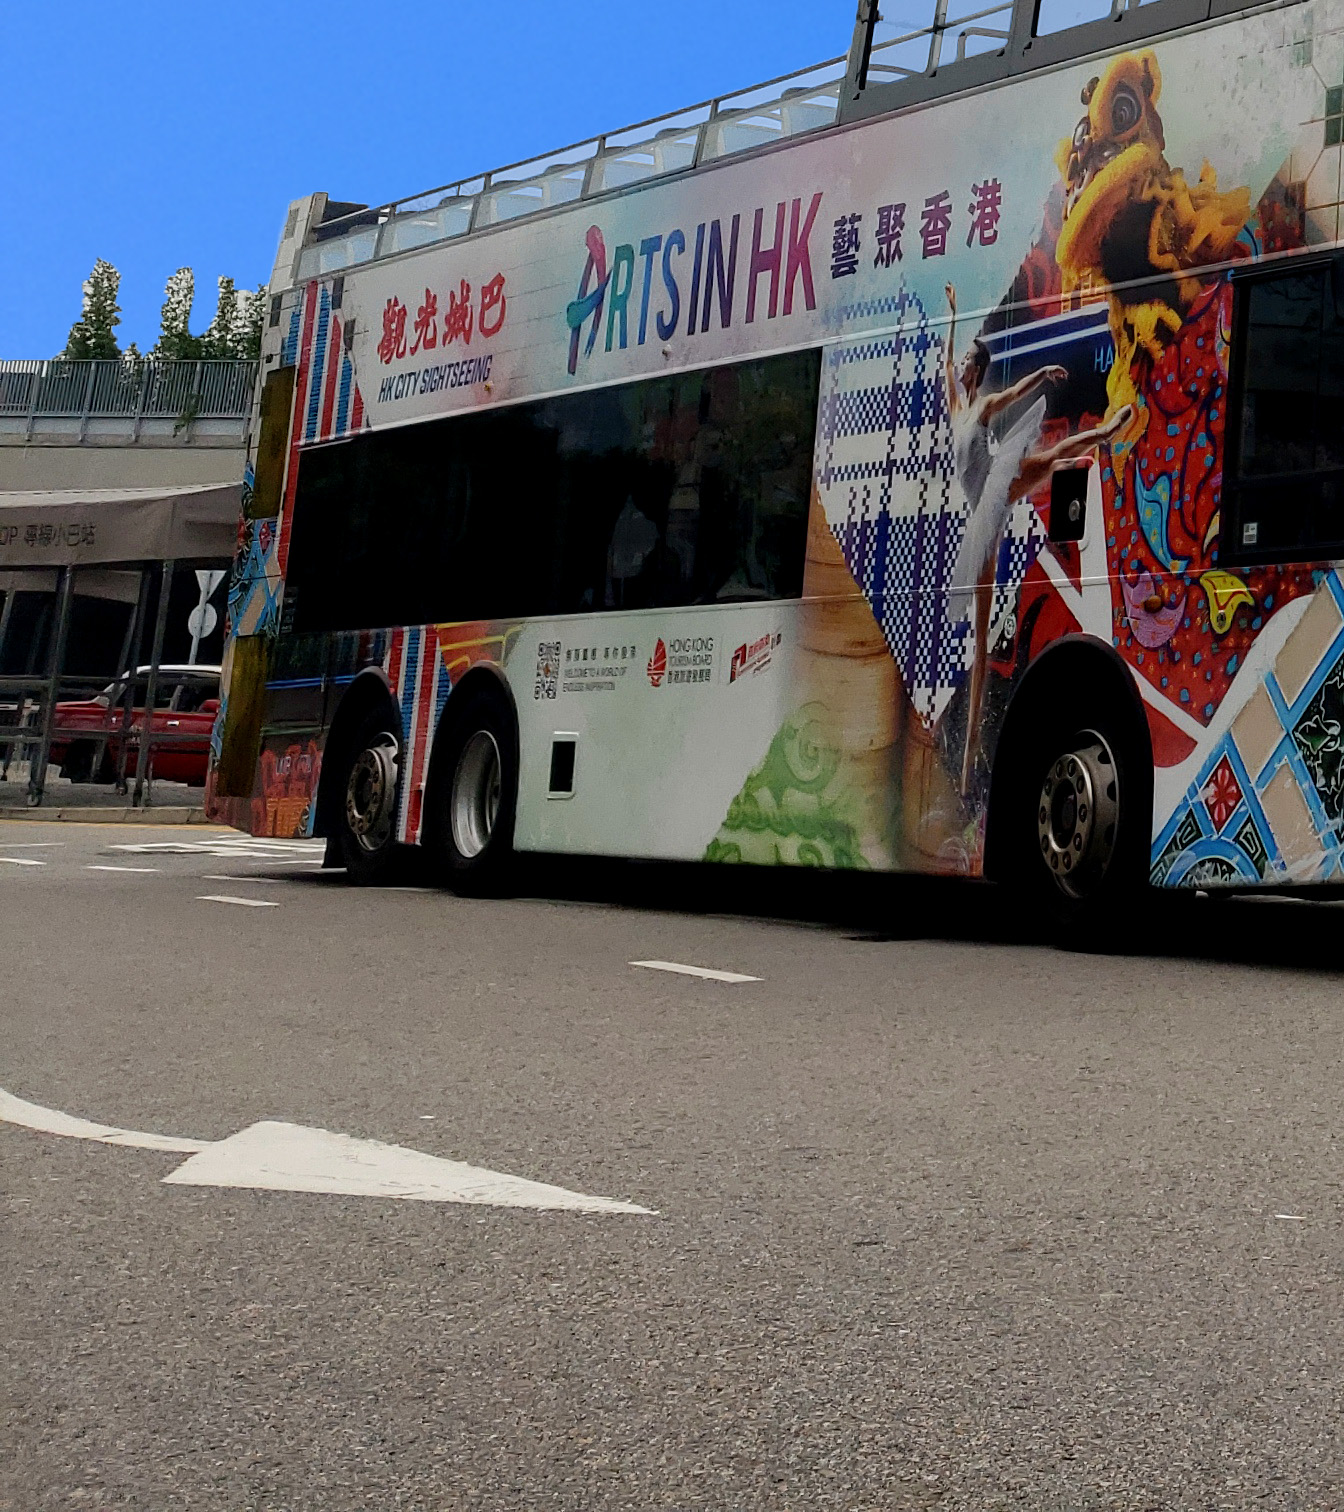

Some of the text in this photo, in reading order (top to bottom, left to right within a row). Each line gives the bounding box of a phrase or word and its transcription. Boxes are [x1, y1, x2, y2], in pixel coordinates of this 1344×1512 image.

[830, 177, 1002, 279] 藝聚香港
[377, 272, 506, 365] 觀光城巴
[566, 192, 823, 376] ARTS IN HK
[378, 354, 493, 403] HK CITY SIGHTSEEING
[669, 637, 714, 653] HONG KONG
